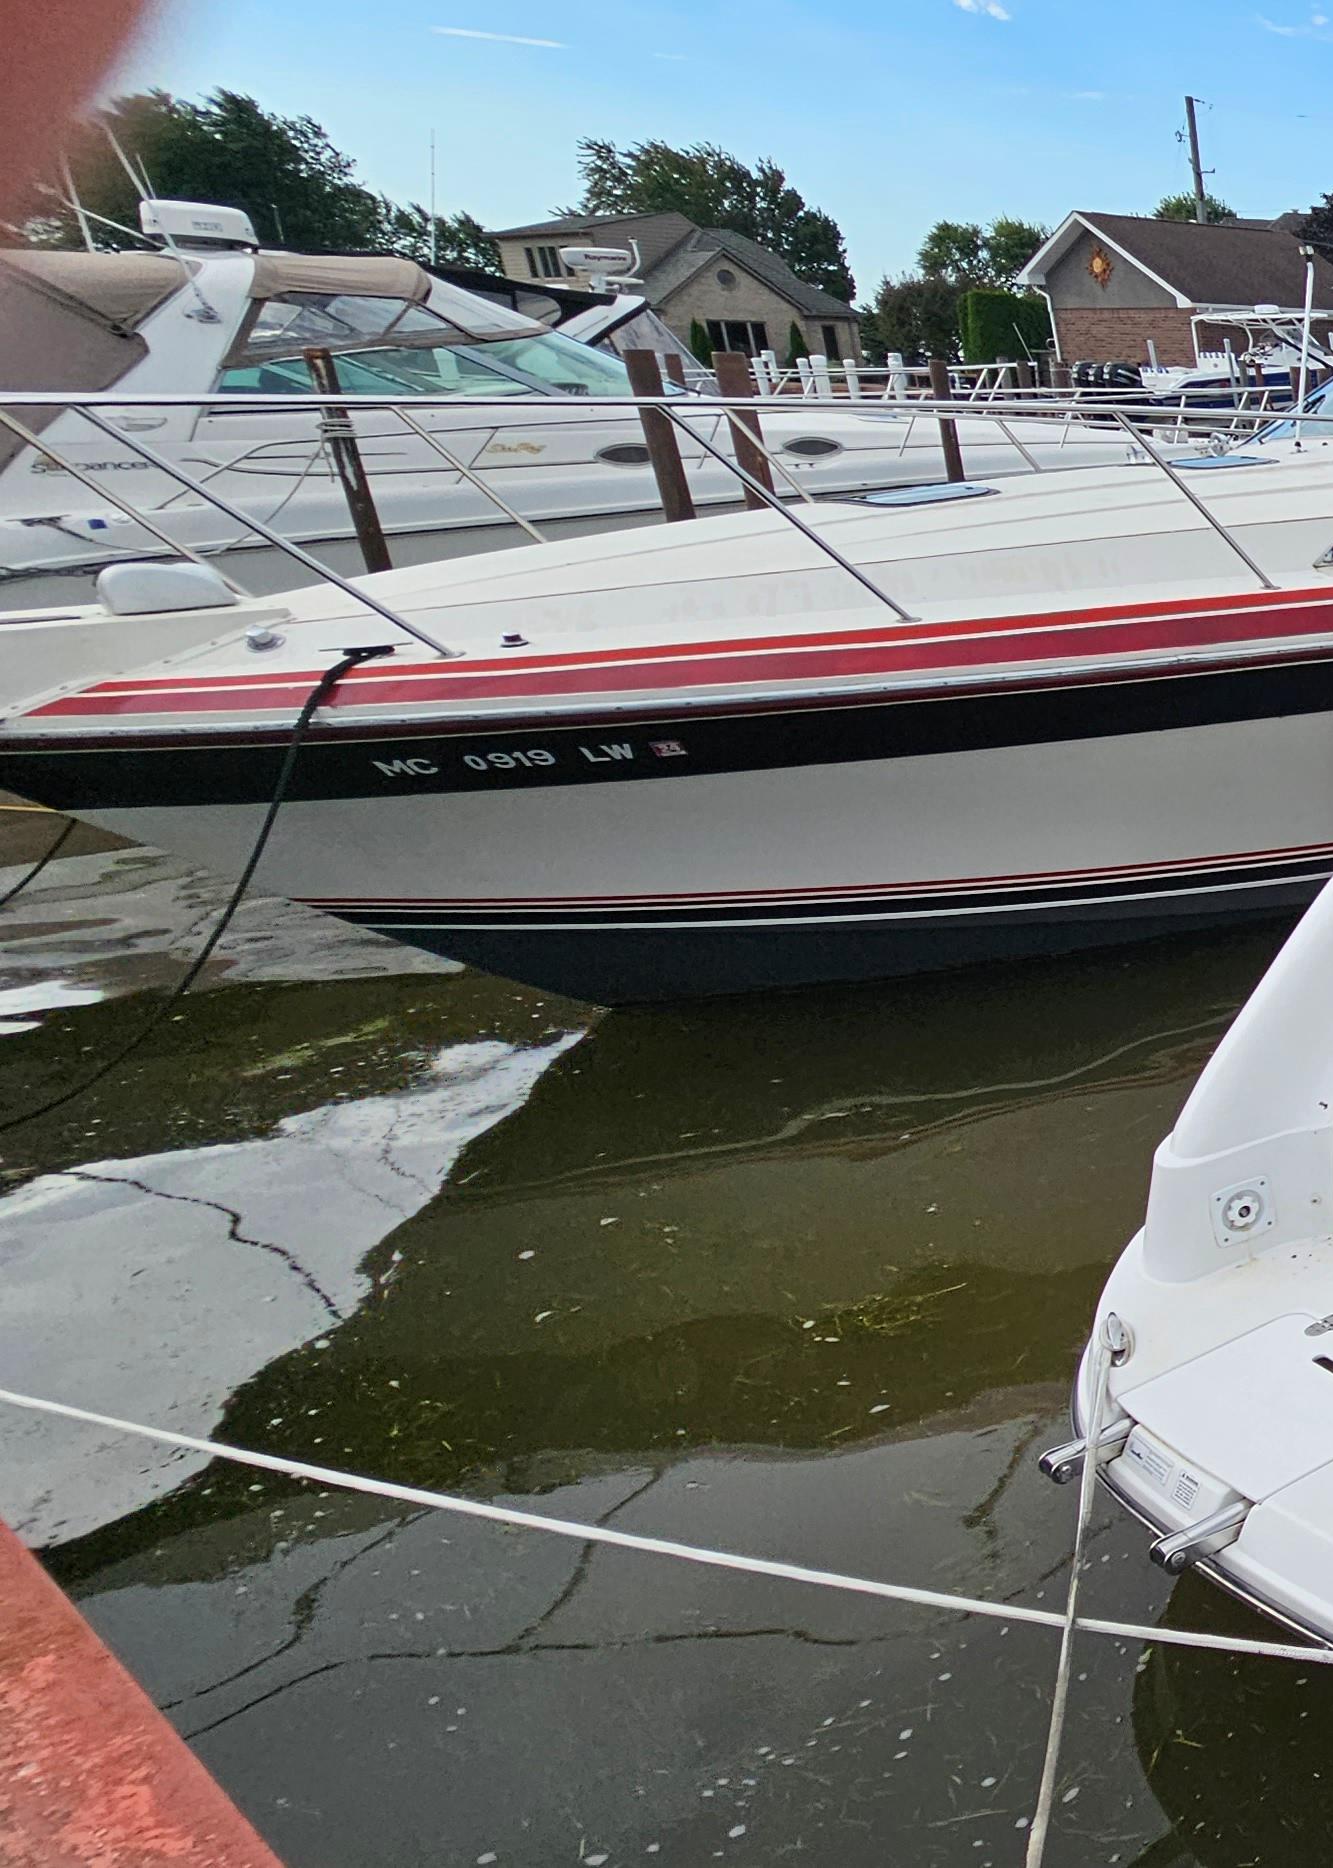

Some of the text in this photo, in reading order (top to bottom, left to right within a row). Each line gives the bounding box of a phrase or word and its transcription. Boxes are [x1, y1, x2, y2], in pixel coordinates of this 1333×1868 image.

[372, 743, 634, 777] MC 0919 LW
